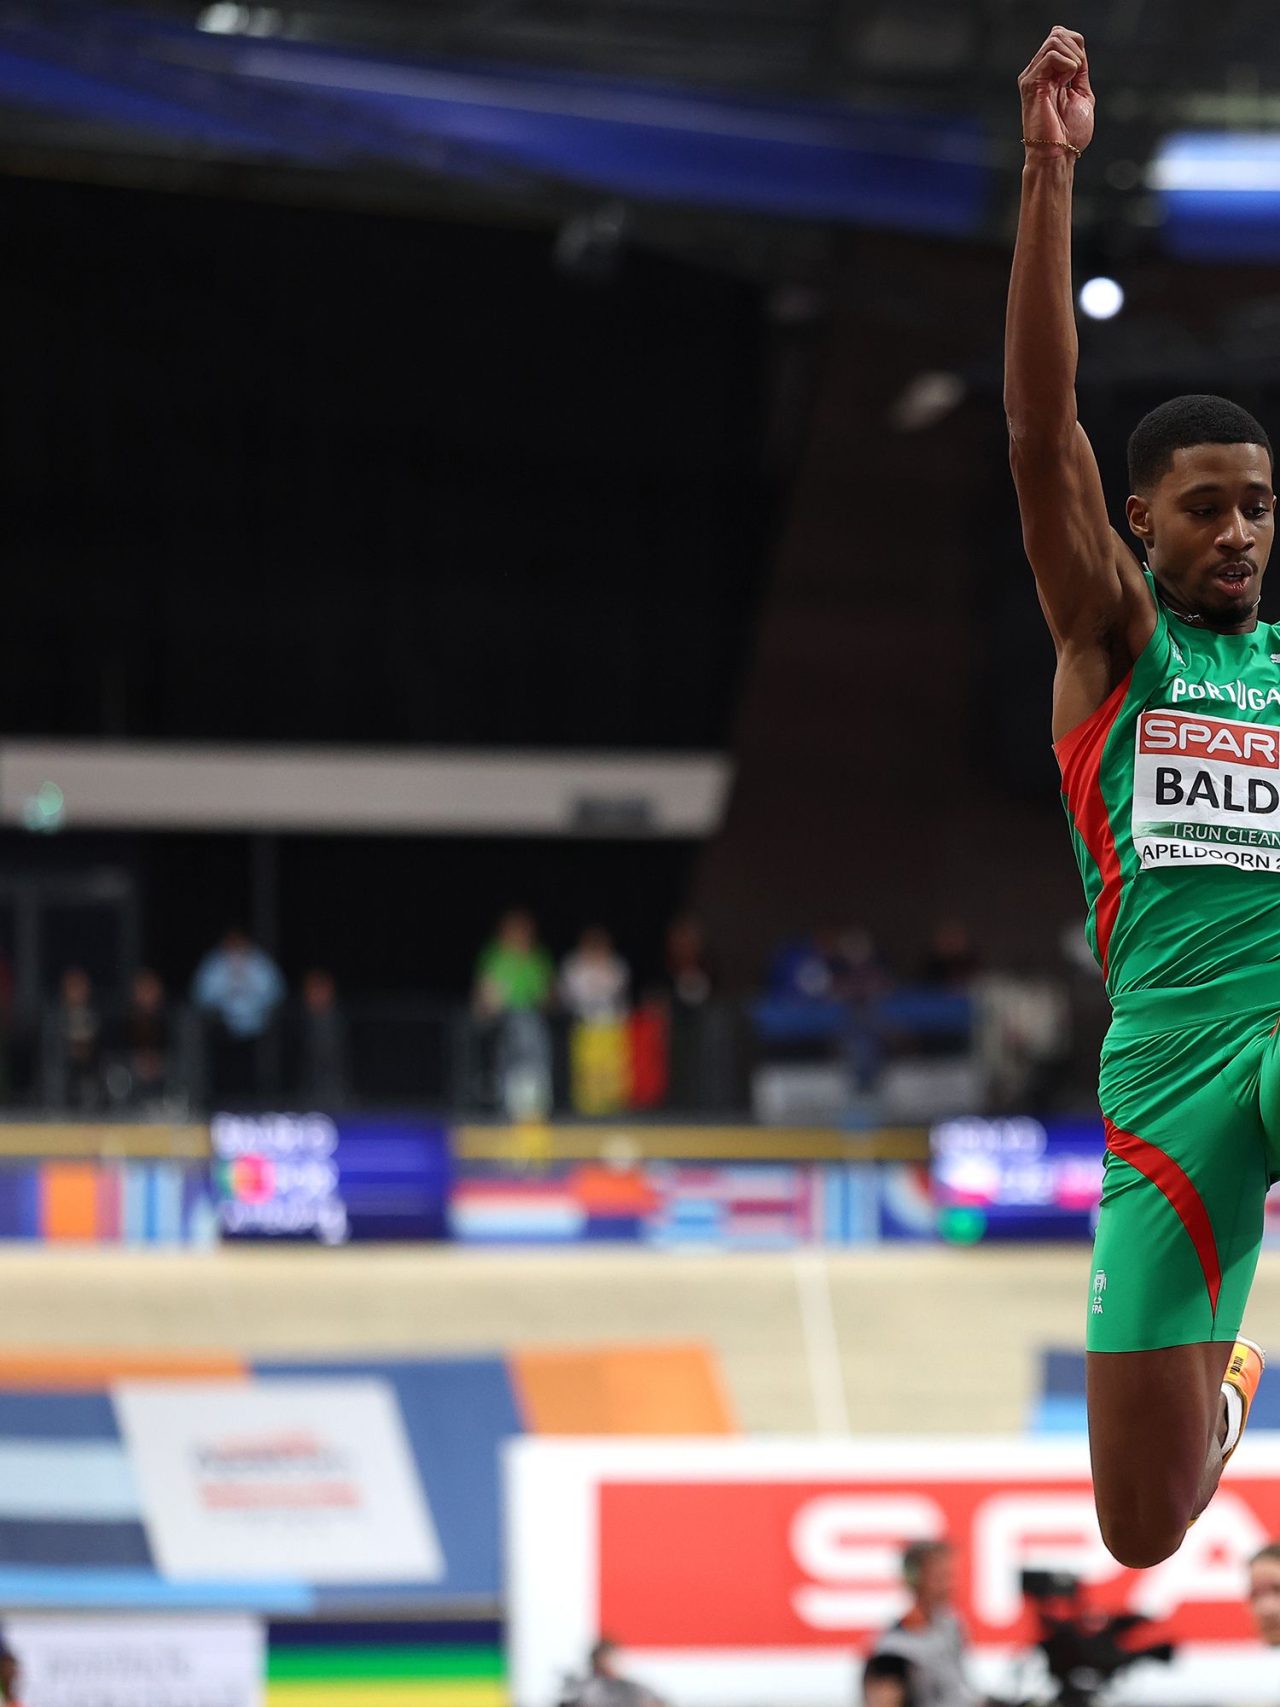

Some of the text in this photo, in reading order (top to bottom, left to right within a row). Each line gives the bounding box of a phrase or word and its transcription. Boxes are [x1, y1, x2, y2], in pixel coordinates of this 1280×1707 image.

[1144, 719, 1276, 763] SPAR
[1182, 823, 1222, 841] RUN
[1143, 844, 1270, 870] APELDOORN
